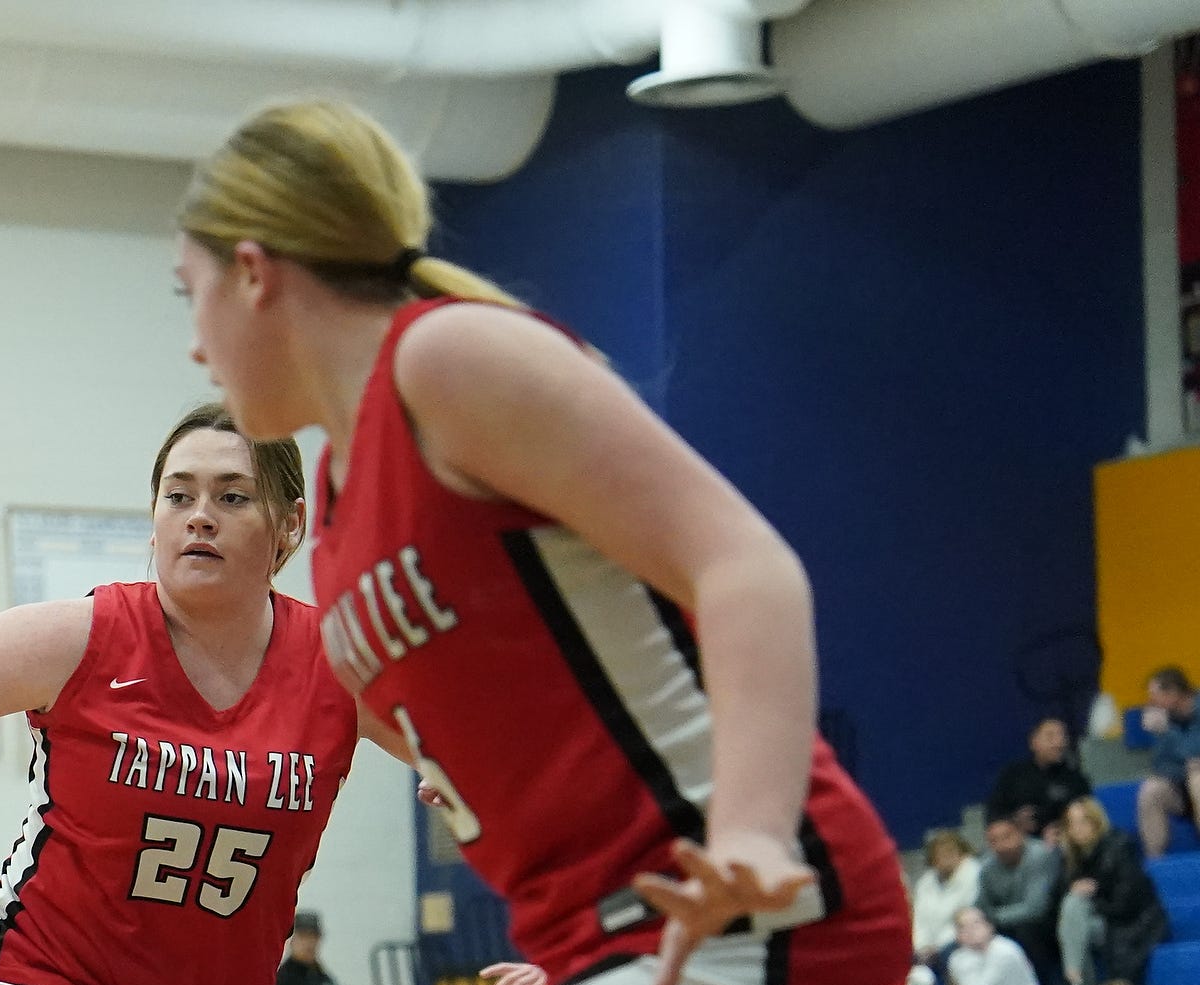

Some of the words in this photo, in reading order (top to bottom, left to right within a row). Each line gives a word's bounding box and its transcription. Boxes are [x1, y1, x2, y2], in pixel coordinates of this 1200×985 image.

[109, 731, 247, 806] TAPPAN
[266, 751, 316, 812] ZEE
[128, 813, 274, 920] 25
